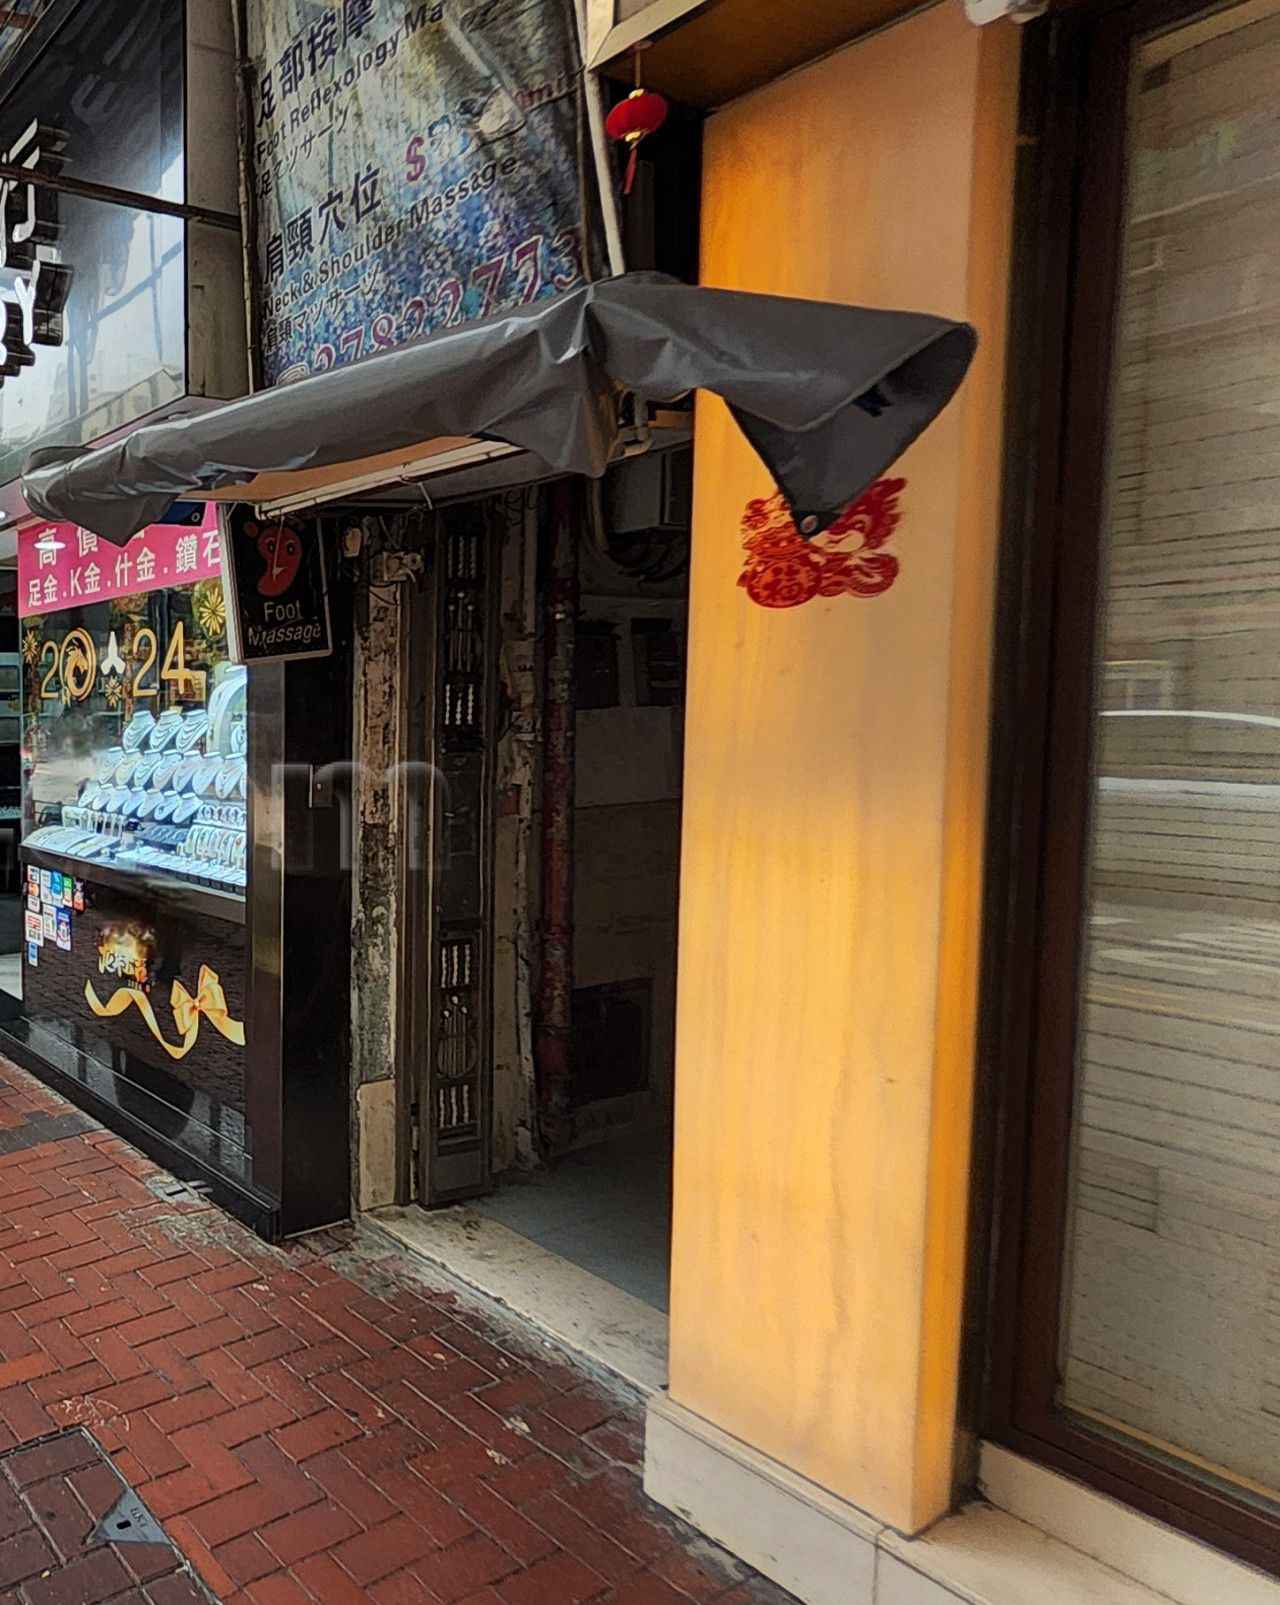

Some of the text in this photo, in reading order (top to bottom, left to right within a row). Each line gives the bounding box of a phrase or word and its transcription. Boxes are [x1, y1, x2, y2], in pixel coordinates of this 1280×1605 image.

[256, 122, 286, 164] Foot
[290, 29, 400, 133] Reflexology
[264, 155, 519, 320] Neck & Shoulder Massage
[248, 600, 321, 648] Foot Massage
